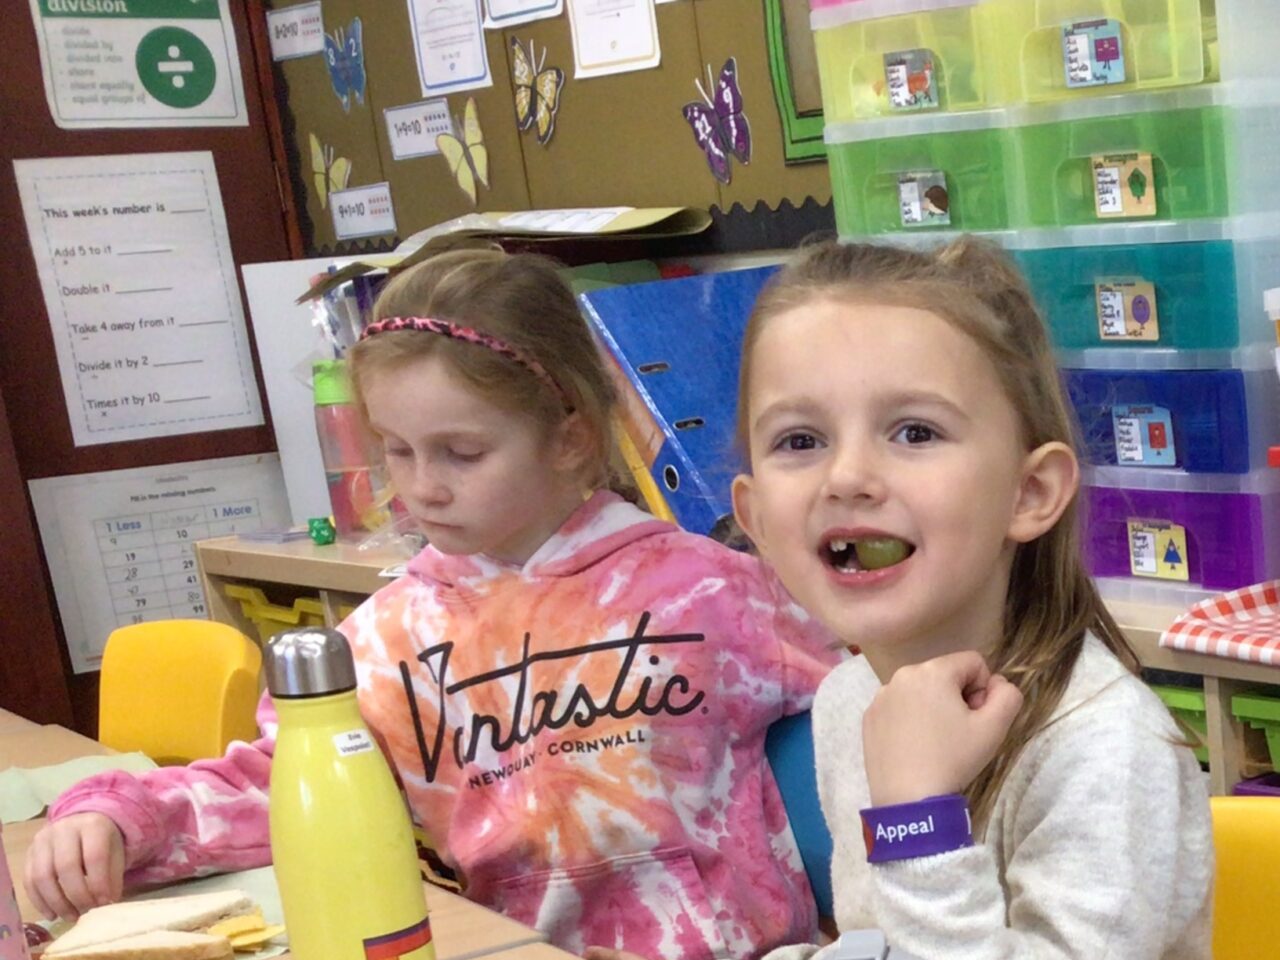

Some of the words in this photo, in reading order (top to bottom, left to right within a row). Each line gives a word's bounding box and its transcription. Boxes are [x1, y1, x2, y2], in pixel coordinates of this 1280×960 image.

[47, 0, 128, 13] division
[43, 208, 68, 218] This
[112, 204, 152, 216] number
[156, 202, 165, 213] is
[54, 247, 76, 257] Add
[78, 246, 86, 256] 5
[89, 246, 101, 255] to
[104, 245, 111, 254] it
[62, 283, 99, 296] Double
[102, 283, 110, 293] it
[71, 323, 98, 334] Take
[100, 321, 107, 331] 4
[111, 321, 135, 332] away
[139, 318, 164, 329] from
[167, 317, 175, 326] it
[78, 360, 112, 372] Divide
[114, 359, 122, 369] it
[126, 357, 138, 370] by
[141, 355, 148, 366] 2
[87, 399, 118, 410] Times
[121, 397, 129, 405] it
[132, 395, 145, 407] by
[148, 392, 160, 403] 10
[222, 505, 252, 517] More
[116, 519, 141, 531] Less
[177, 529, 188, 539] 10
[126, 552, 136, 562] 19
[183, 560, 194, 570] 29
[187, 575, 197, 584] 41
[468, 753, 536, 789] NEWQUAY
[547, 729, 646, 756] CORNWALL
[876, 815, 934, 843] Appeal
